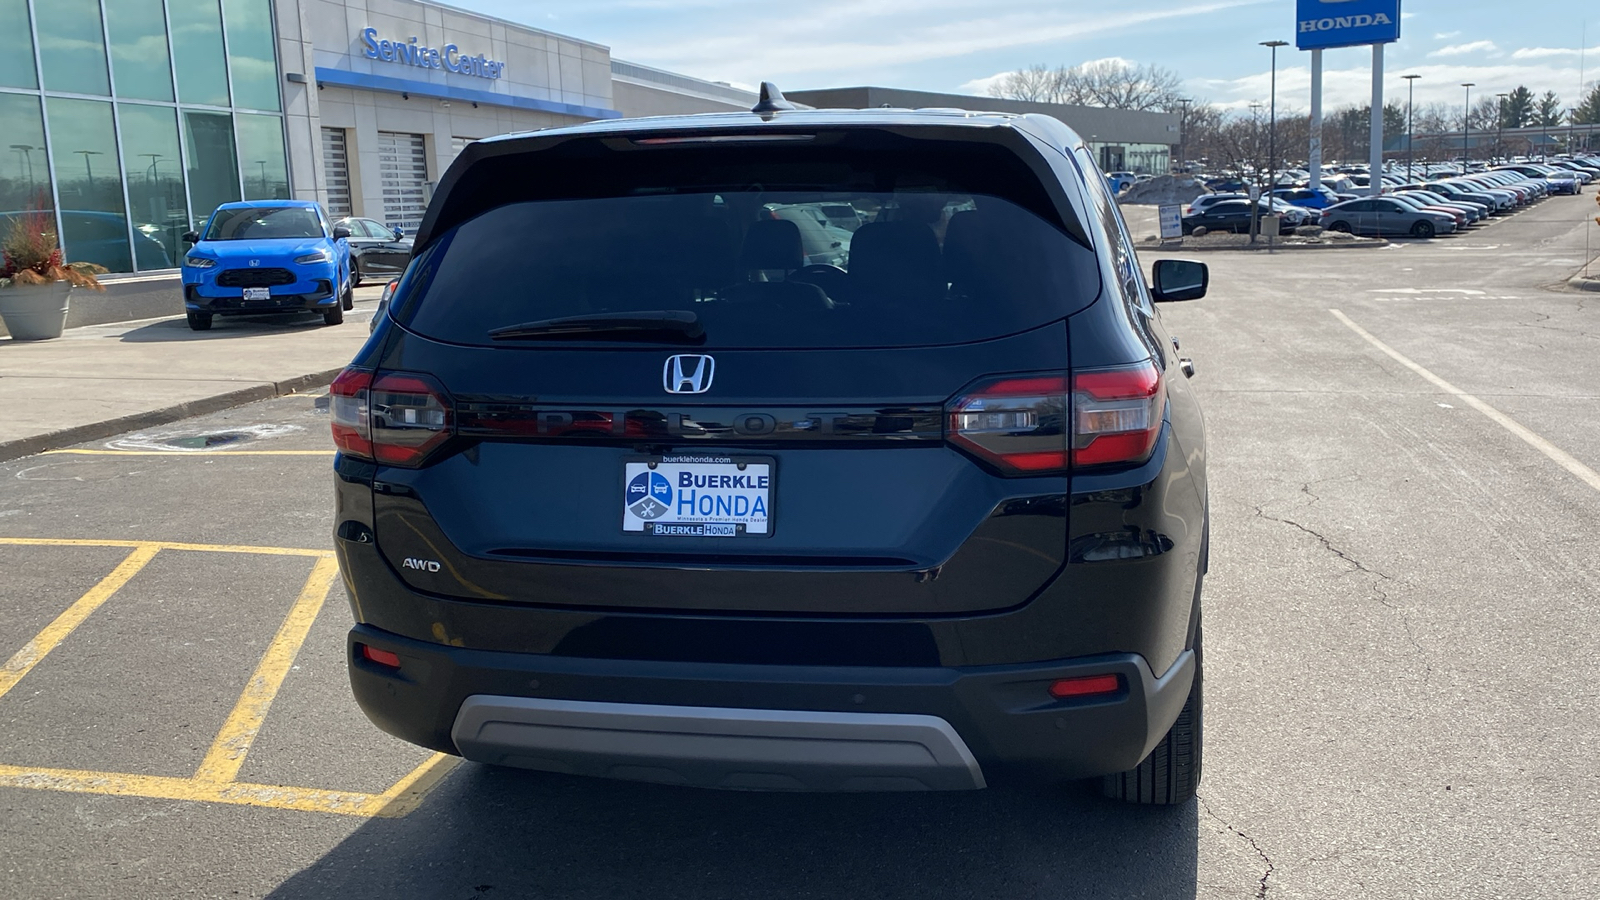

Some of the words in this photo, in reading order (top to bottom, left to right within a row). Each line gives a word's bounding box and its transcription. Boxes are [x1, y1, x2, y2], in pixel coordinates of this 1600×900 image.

[1298, 13, 1392, 33] HONDA
[360, 27, 440, 69] Service
[440, 43, 505, 79] Center
[536, 412, 849, 435] PILOT
[662, 455, 731, 463] buerklehonda.com
[678, 471, 769, 489] BUERKLE
[677, 489, 767, 517] HONDA
[654, 524, 703, 535] BUERKLE
[704, 524, 735, 535] HONDA
[402, 557, 441, 573] AWD
